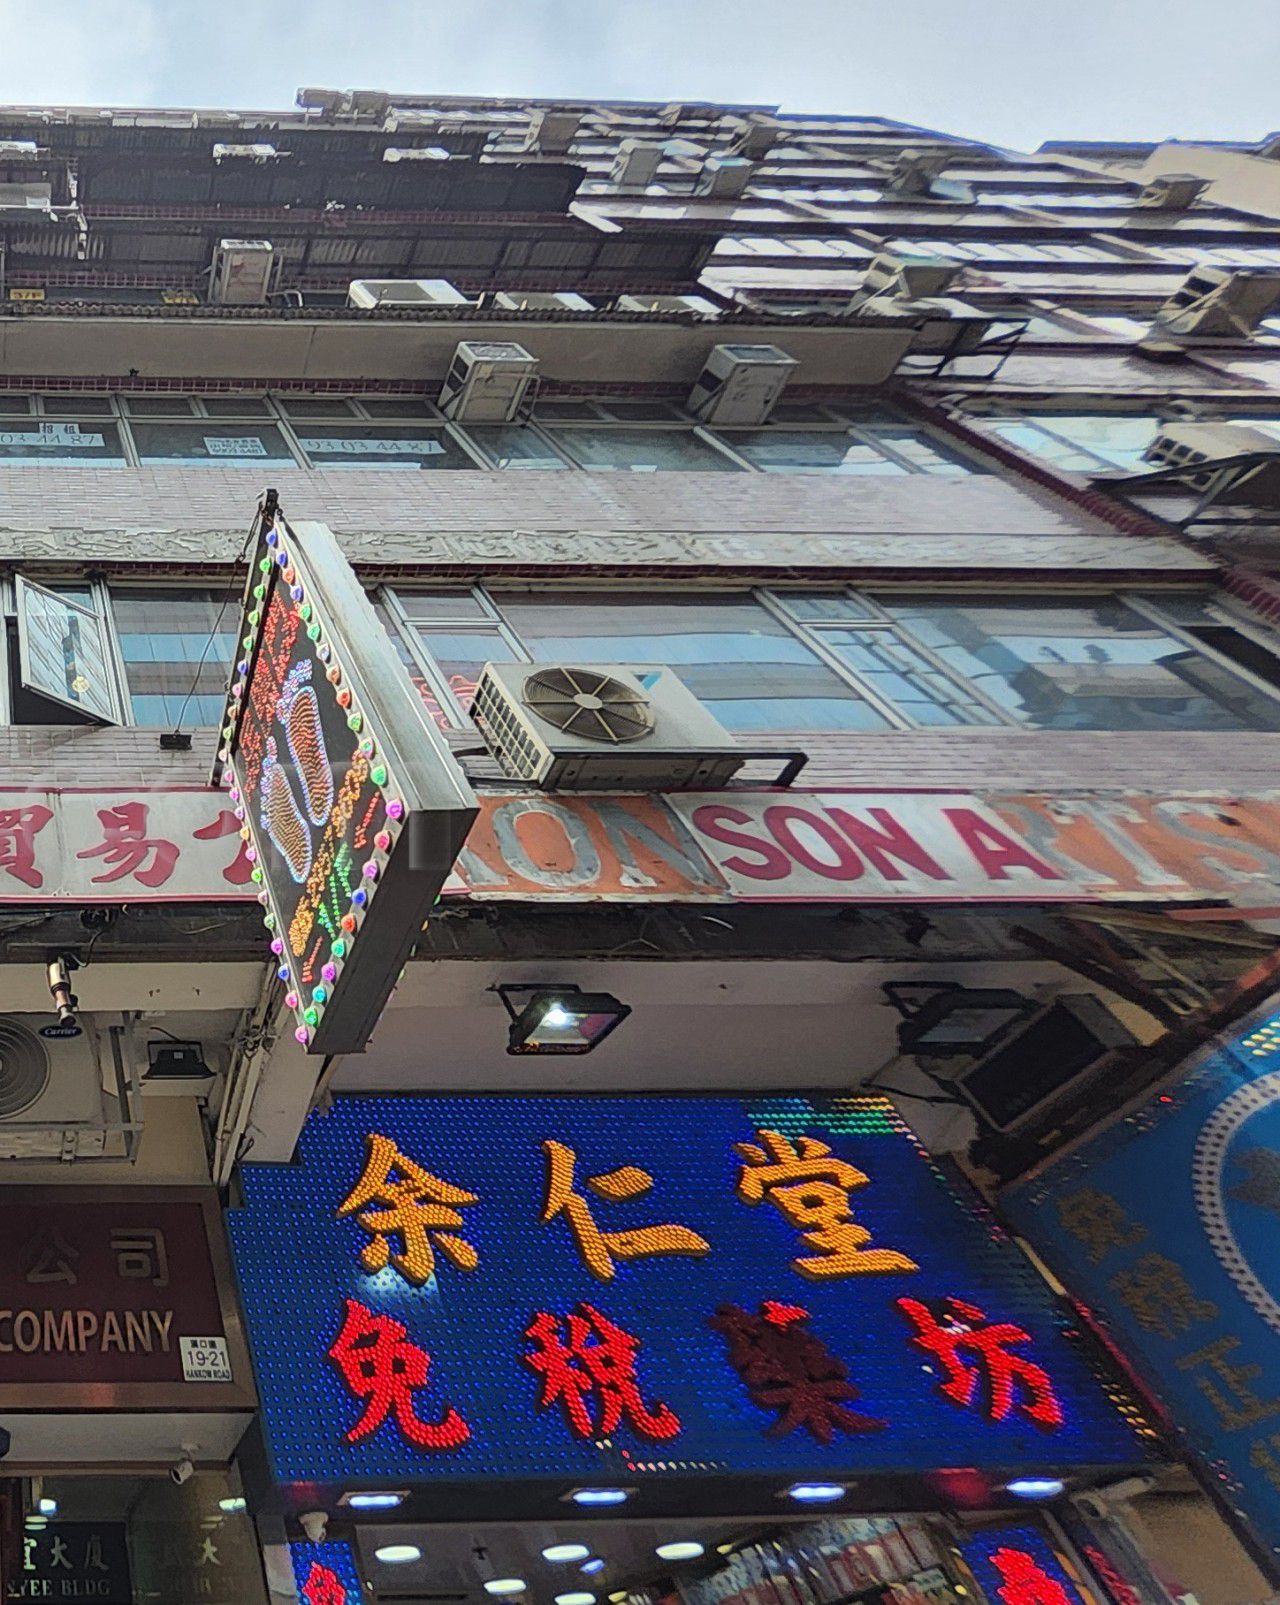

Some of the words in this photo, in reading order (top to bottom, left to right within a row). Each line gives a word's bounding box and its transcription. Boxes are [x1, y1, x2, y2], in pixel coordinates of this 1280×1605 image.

[336, 1130, 921, 1283] 余仁堂
[187, 1350, 226, 1366] 19-21
